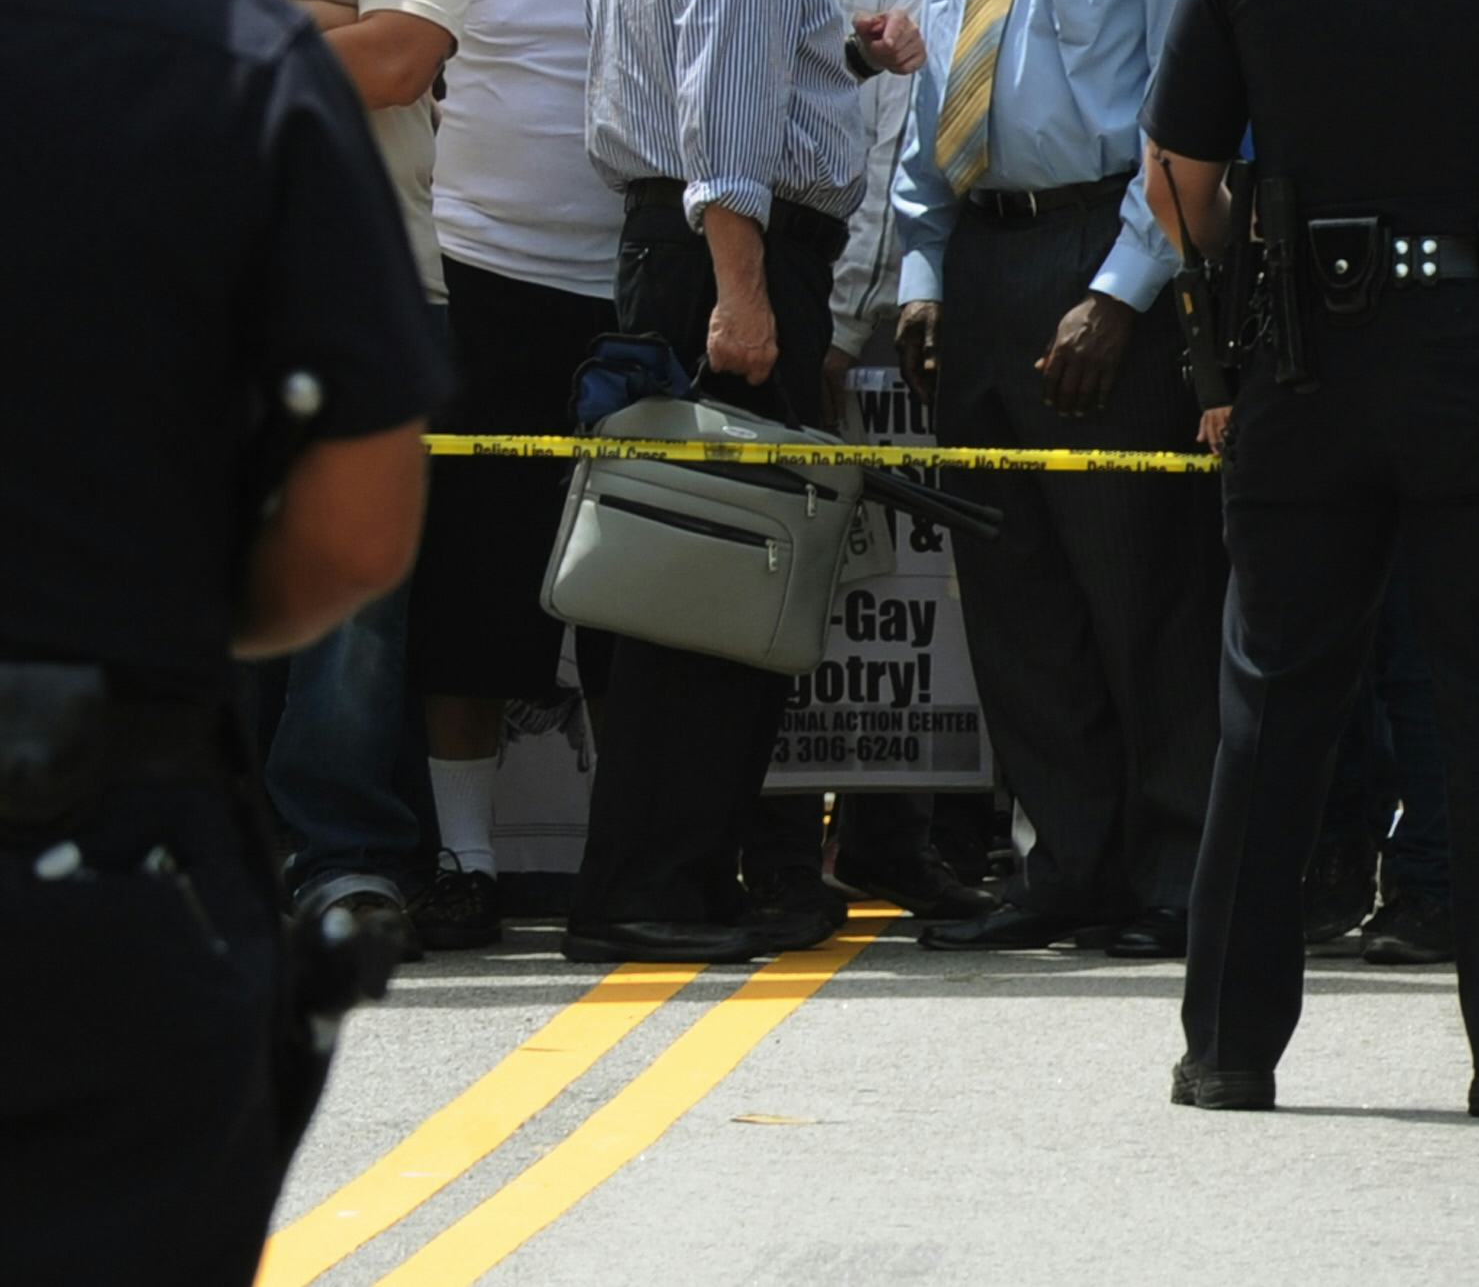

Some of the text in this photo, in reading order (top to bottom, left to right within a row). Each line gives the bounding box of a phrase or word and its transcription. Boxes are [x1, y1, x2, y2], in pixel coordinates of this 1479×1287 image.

[830, 590, 936, 647] -Gay
[787, 654, 931, 710] gotry!
[833, 711, 903, 733] ACTION
[908, 712, 979, 733] CENTER
[798, 735, 920, 763] 306-6240
